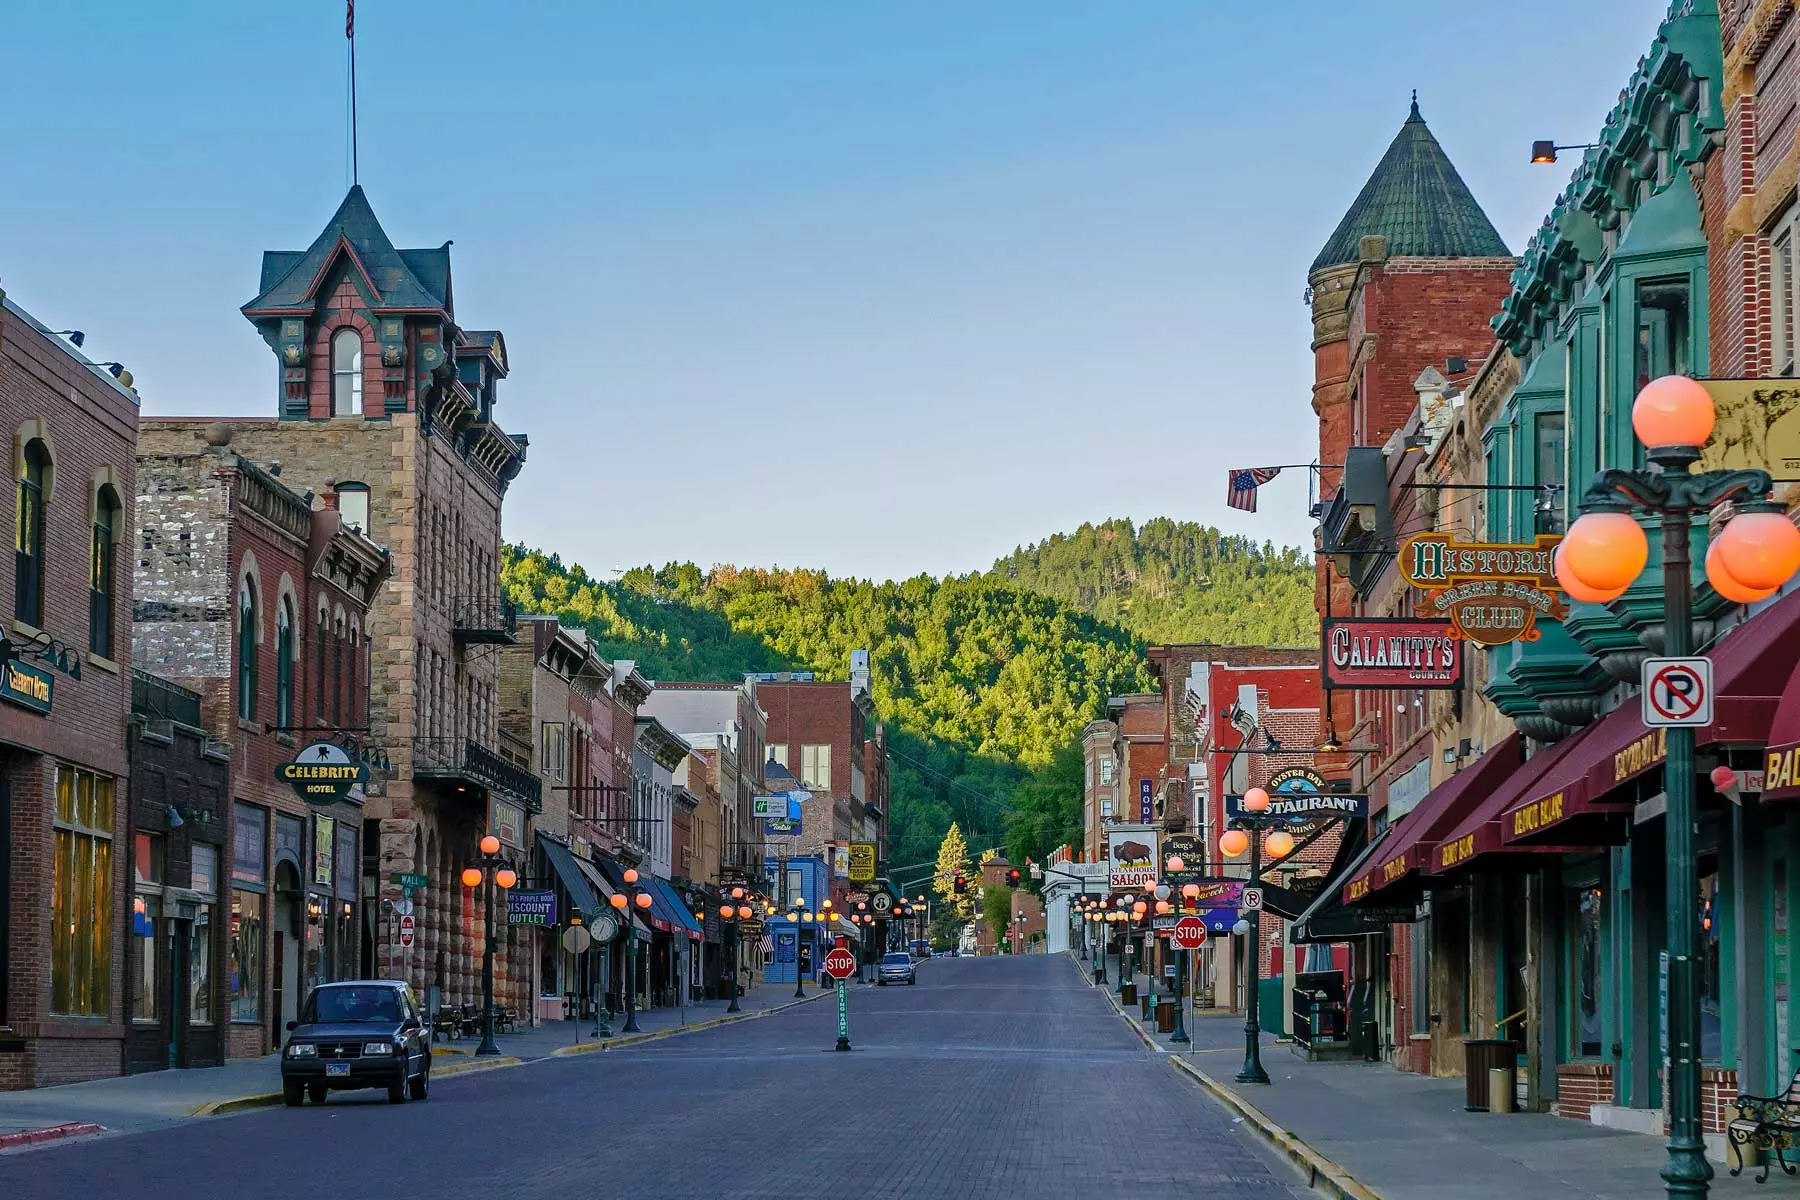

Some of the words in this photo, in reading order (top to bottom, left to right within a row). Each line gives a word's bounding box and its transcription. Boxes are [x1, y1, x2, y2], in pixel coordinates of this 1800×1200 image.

[1434, 580, 1498, 611] GREEN
[1501, 581, 1551, 612] DOOR
[1461, 606, 1525, 630] CLUB
[1331, 627, 1455, 668] CALAMITY'S
[1409, 671, 1452, 680] COUNTRY
[284, 766, 360, 779] CELEBRITY
[1271, 769, 1305, 787] OYSTER
[1307, 772, 1325, 787] BAY
[307, 784, 336, 793] HOTEL
[1236, 797, 1358, 815] RSTAURANT
[1172, 841, 1194, 851] Berg's
[1182, 852, 1202, 860] Strike
[401, 877, 419, 885] WALL
[1112, 874, 1156, 886] SALOON
[509, 913, 546, 924] OUTLET
[1177, 927, 1205, 939] STOP
[827, 958, 853, 969] STOP
